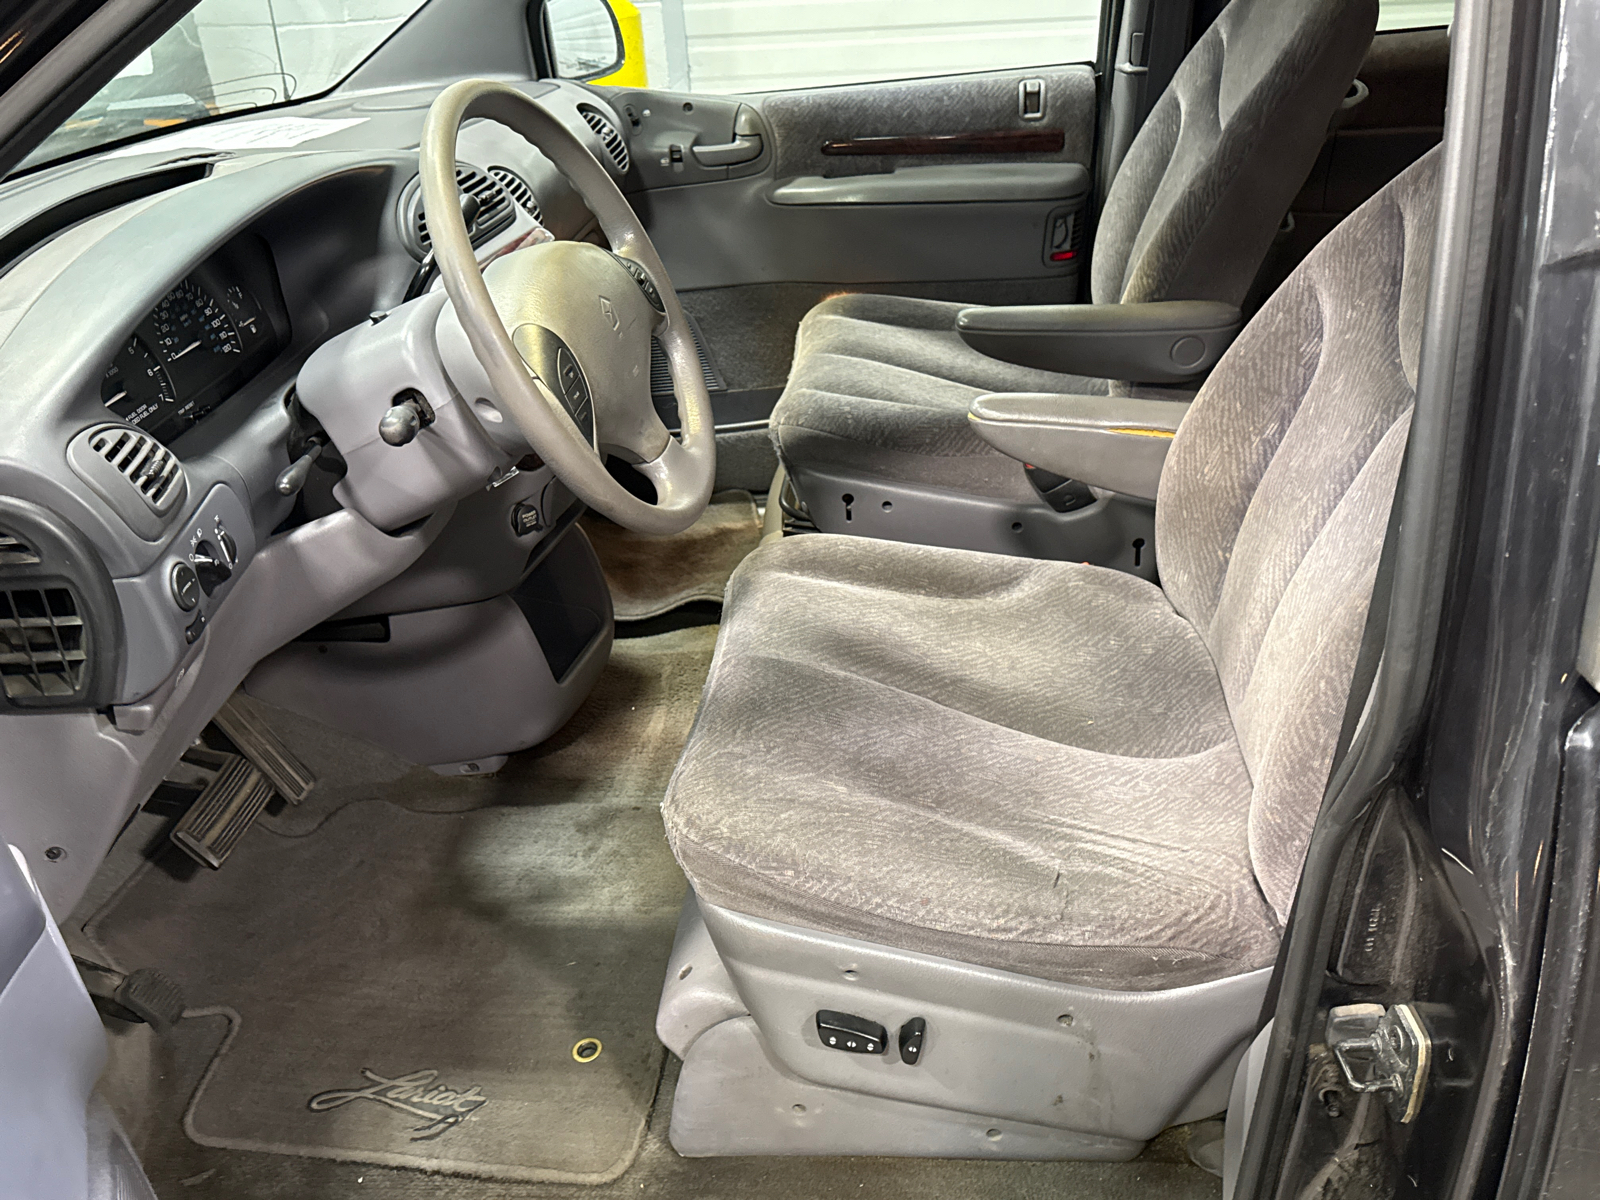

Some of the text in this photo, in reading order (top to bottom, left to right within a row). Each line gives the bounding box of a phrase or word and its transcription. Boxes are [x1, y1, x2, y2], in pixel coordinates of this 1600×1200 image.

[185, 292, 194, 301] 70
[161, 299, 170, 308] 40
[195, 298, 204, 307] 80
[160, 310, 169, 320] 30
[204, 306, 213, 316] 90
[211, 318, 221, 328] 100
[160, 323, 170, 333] 20
[218, 330, 228, 340] 110
[164, 337, 173, 346] 10
[127, 346, 135, 355] 5
[222, 343, 232, 353] 120
[170, 352, 177, 360] 0
[146, 368, 154, 377] 6
[158, 393, 164, 402] 7
[127, 403, 148, 420] FUEL DOOR
[139, 410, 150, 420] FUEL
[148, 402, 159, 414] ONLY
